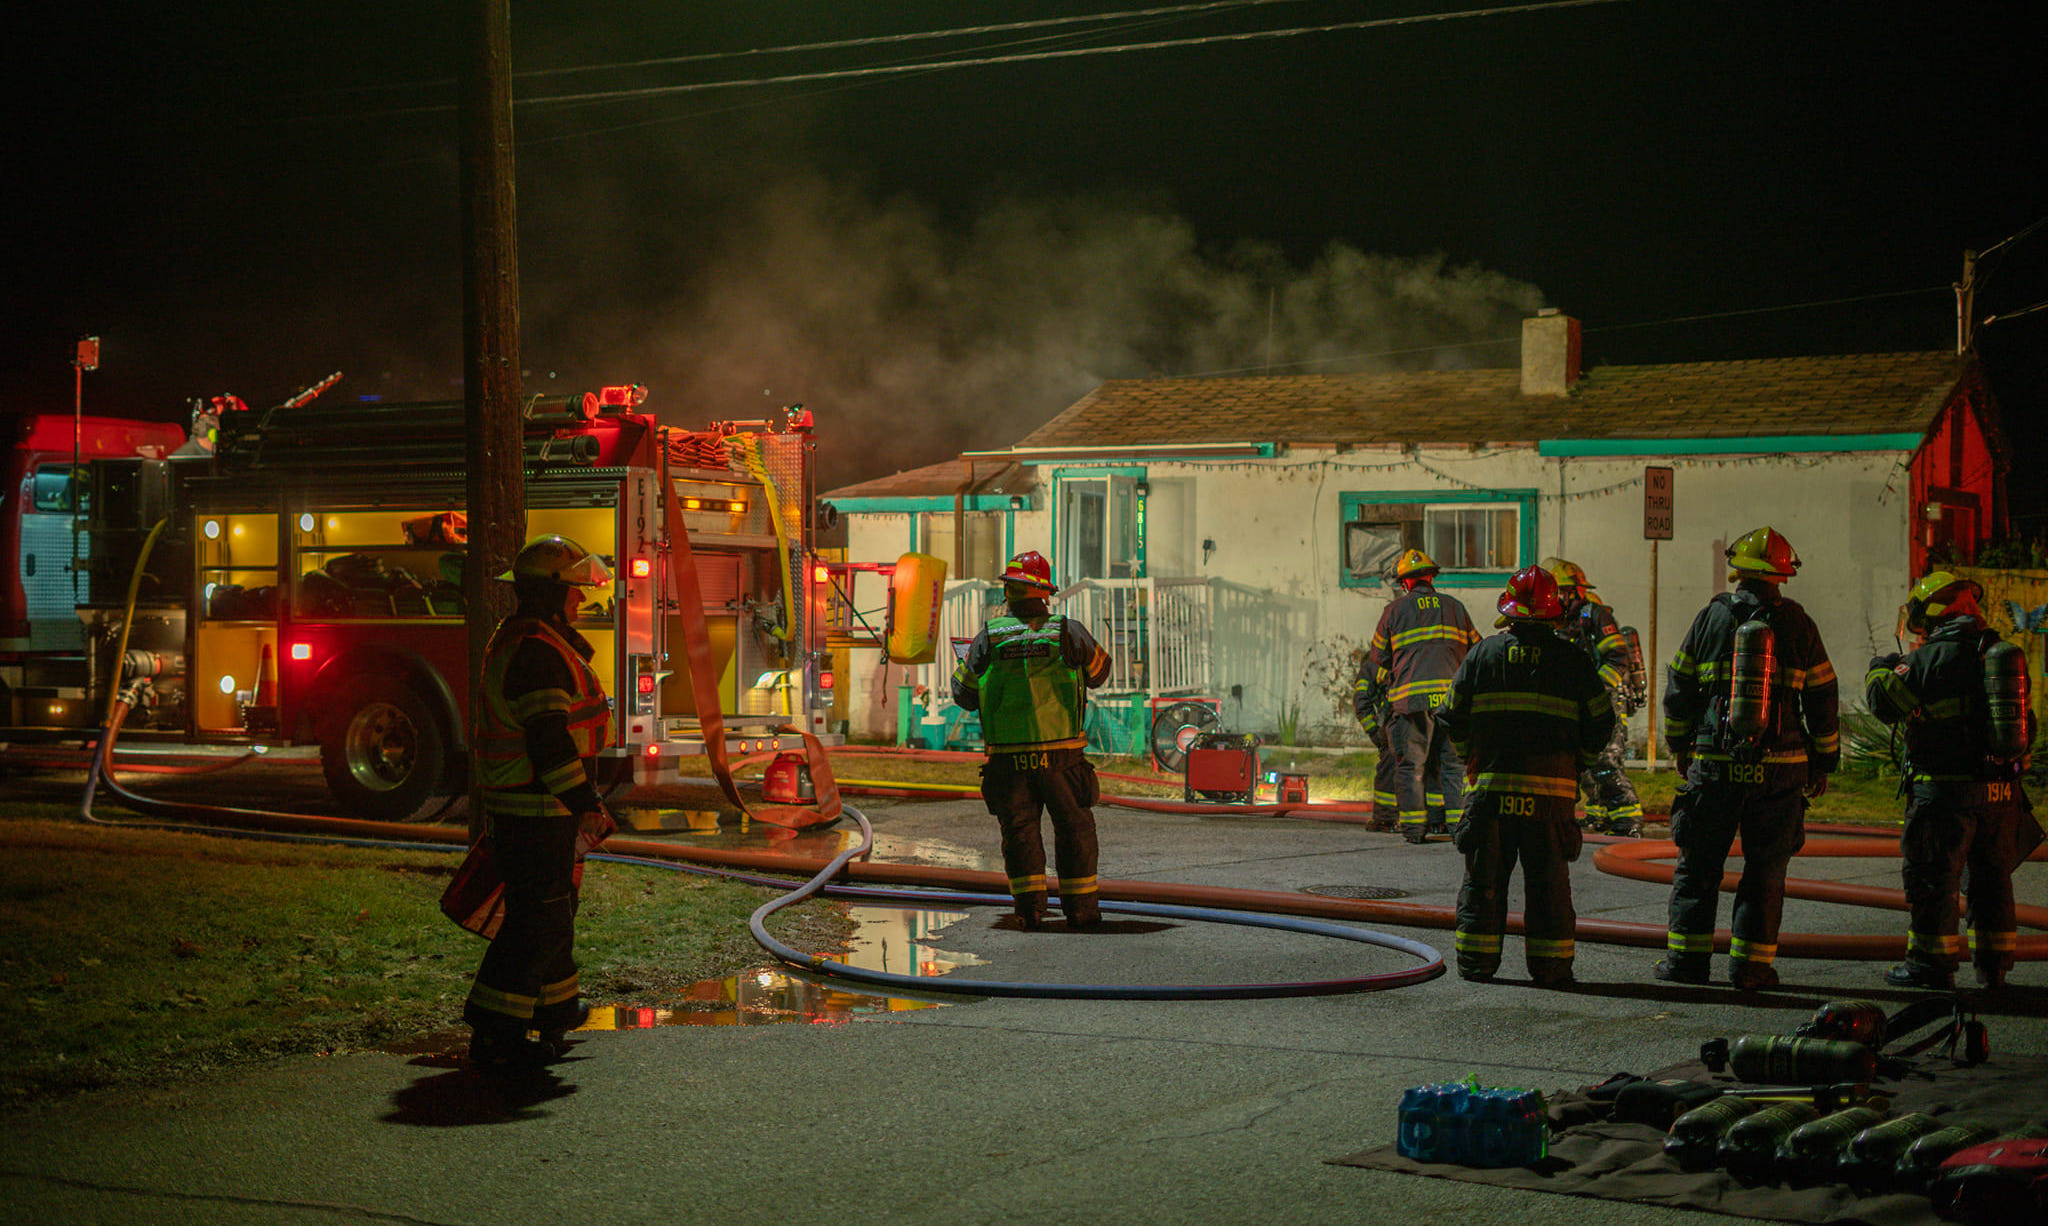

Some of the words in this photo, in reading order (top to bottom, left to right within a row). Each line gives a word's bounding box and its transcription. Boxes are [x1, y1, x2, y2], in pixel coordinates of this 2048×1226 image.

[1653, 475, 1665, 489] NO
[1648, 495, 1670, 510] THRU
[637, 478, 645, 553] E192
[1648, 516, 1670, 532] ROAD
[1417, 596, 1440, 609] OFR
[1508, 645, 1541, 664] OFR
[1012, 752, 1049, 770] 1904
[1728, 763, 1764, 784] 1928
[1987, 782, 2011, 802] 1914
[1499, 795, 1535, 816] 1903
